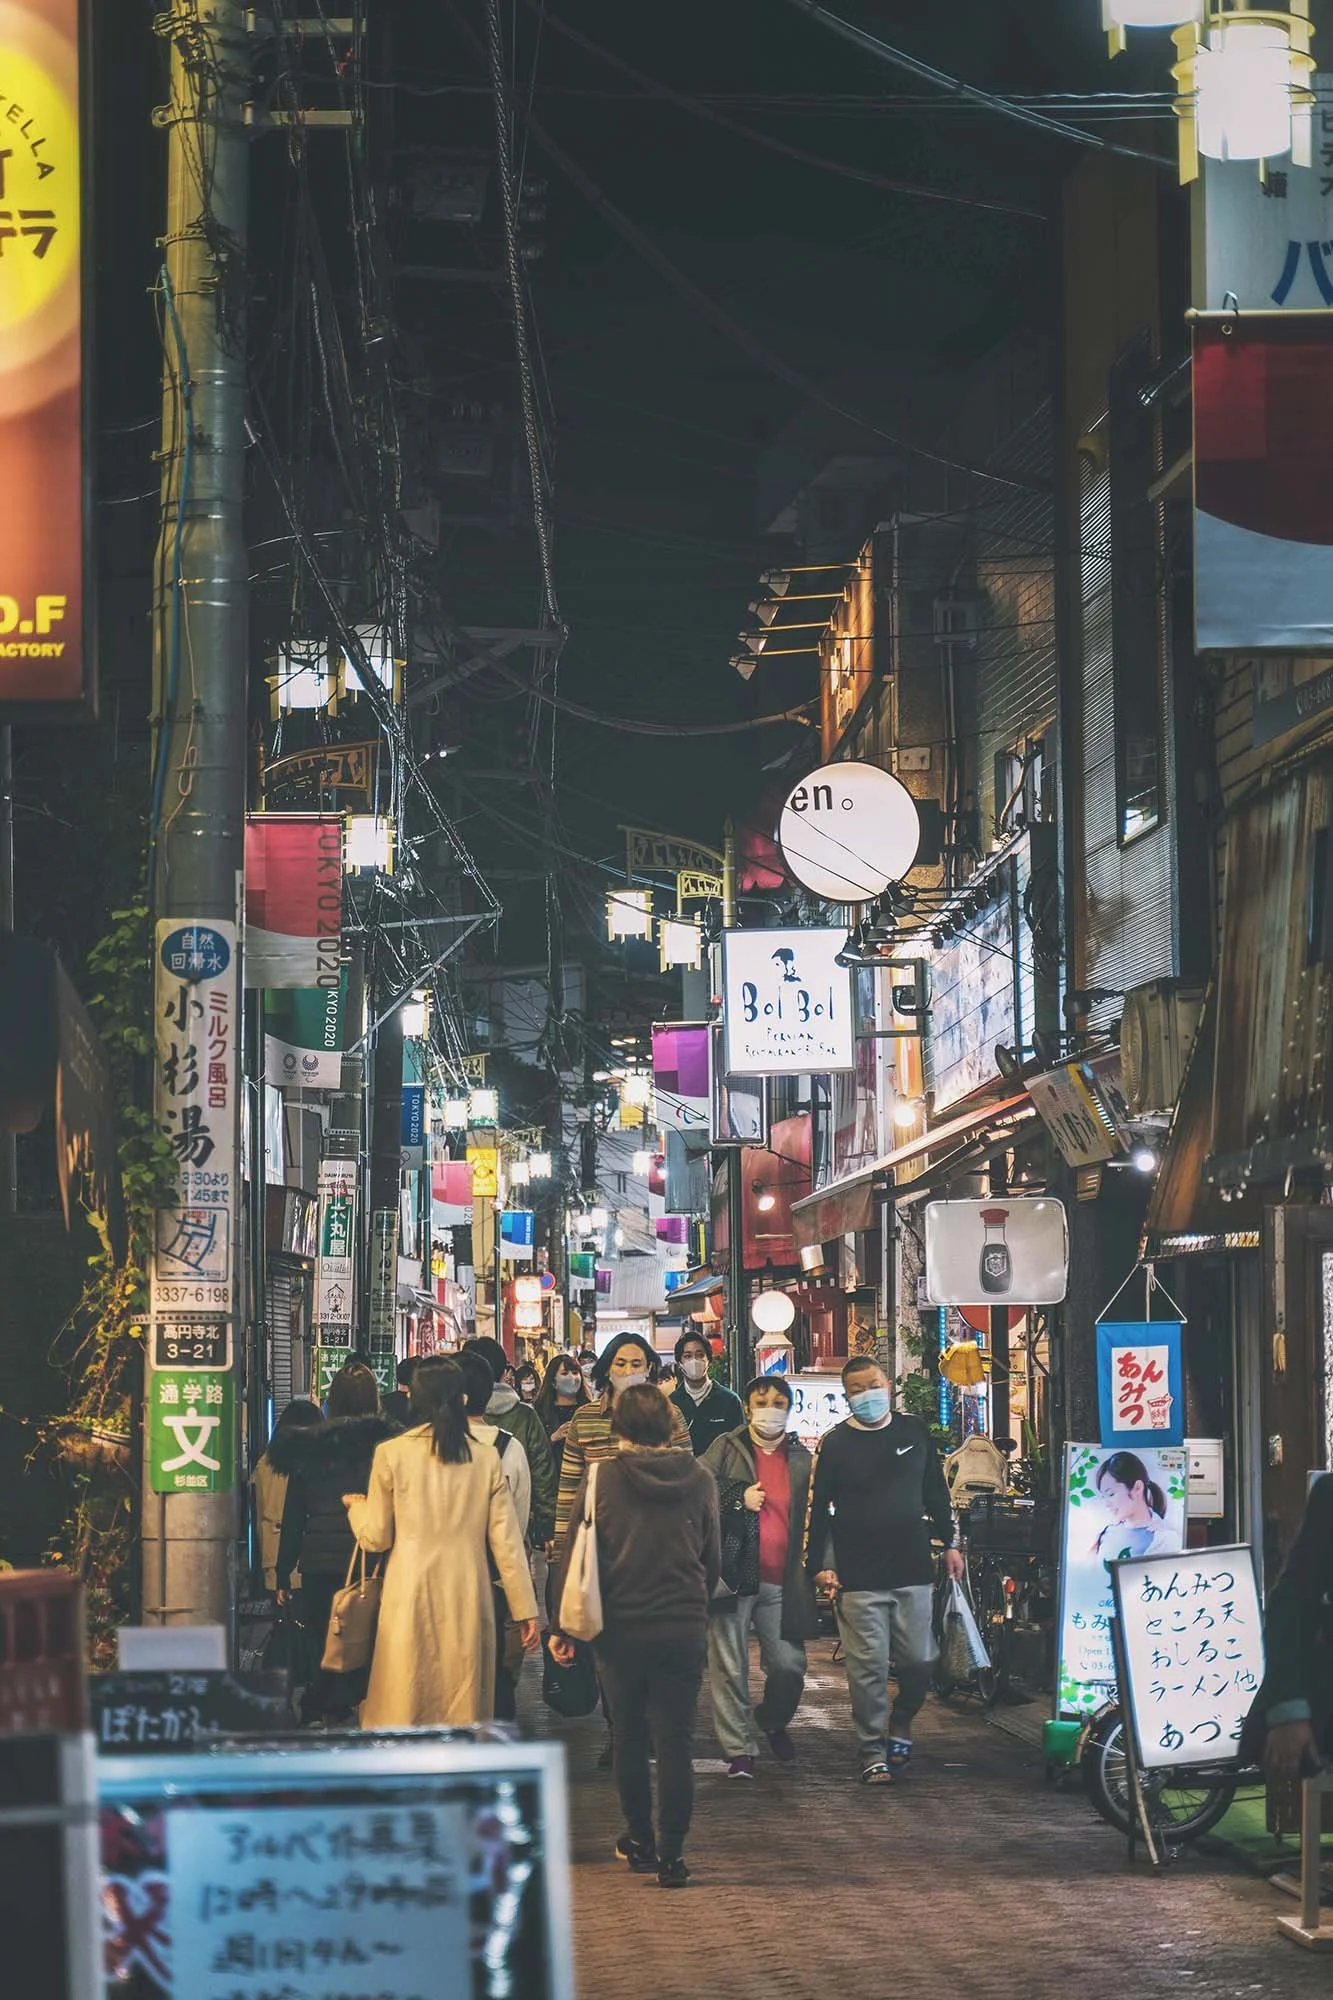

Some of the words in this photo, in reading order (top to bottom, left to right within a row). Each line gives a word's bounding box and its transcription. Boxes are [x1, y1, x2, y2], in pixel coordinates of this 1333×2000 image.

[0, 95, 56, 181] ELLA
[317, 834, 341, 912] OKYO
[181, 932, 216, 951] 自然
[317, 919, 341, 988] 2020
[329, 986, 340, 1015] KYO
[742, 981, 782, 1023] Bol
[797, 985, 834, 1023] Bol
[324, 1016, 337, 1047] 2020
[207, 991, 229, 1109] ミルク風呂
[162, 984, 216, 1169] 小杉湯
[410, 1122, 419, 1144] 2020
[155, 1287, 229, 1303] 3337-6198
[163, 1324, 220, 1340] 高円寺北
[167, 1344, 214, 1359] 3-21
[159, 1383, 224, 1405] 通学路
[160, 1406, 222, 1472] 文
[1139, 1571, 1235, 1603] あんみつ
[1144, 1600, 1246, 1637] ところ天
[1150, 1637, 1243, 1670] おしるこ
[1149, 1668, 1259, 1703] ラーメン他
